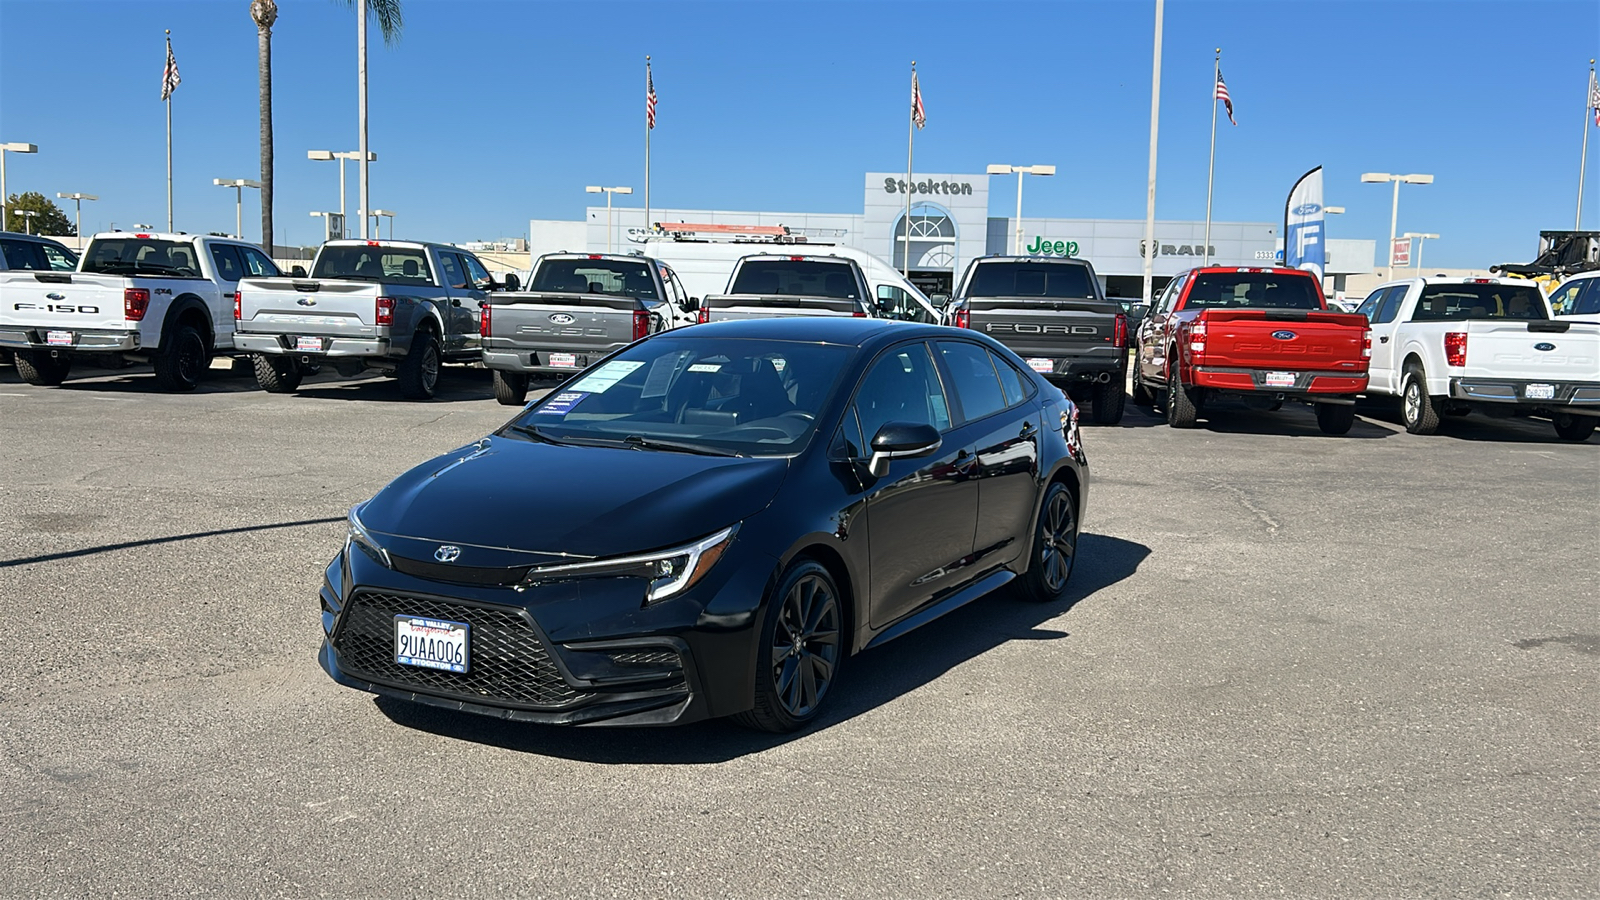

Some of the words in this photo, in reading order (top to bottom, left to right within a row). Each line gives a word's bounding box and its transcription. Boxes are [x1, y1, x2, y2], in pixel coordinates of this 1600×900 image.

[884, 177, 973, 195] Stockton
[1298, 205, 1317, 215] Ford
[1026, 235, 1080, 256] Jeep
[1161, 244, 1215, 256] RAM
[1256, 251, 1275, 259] 3333
[13, 303, 100, 314] F-150
[516, 325, 607, 337] F-150
[986, 322, 1098, 335] FORD
[1233, 342, 1333, 355] F-150
[1494, 352, 1595, 366] F-150
[425, 620, 451, 629] VALLEY
[400, 634, 463, 664] 9UAA006
[411, 658, 451, 670] STOCKTON
